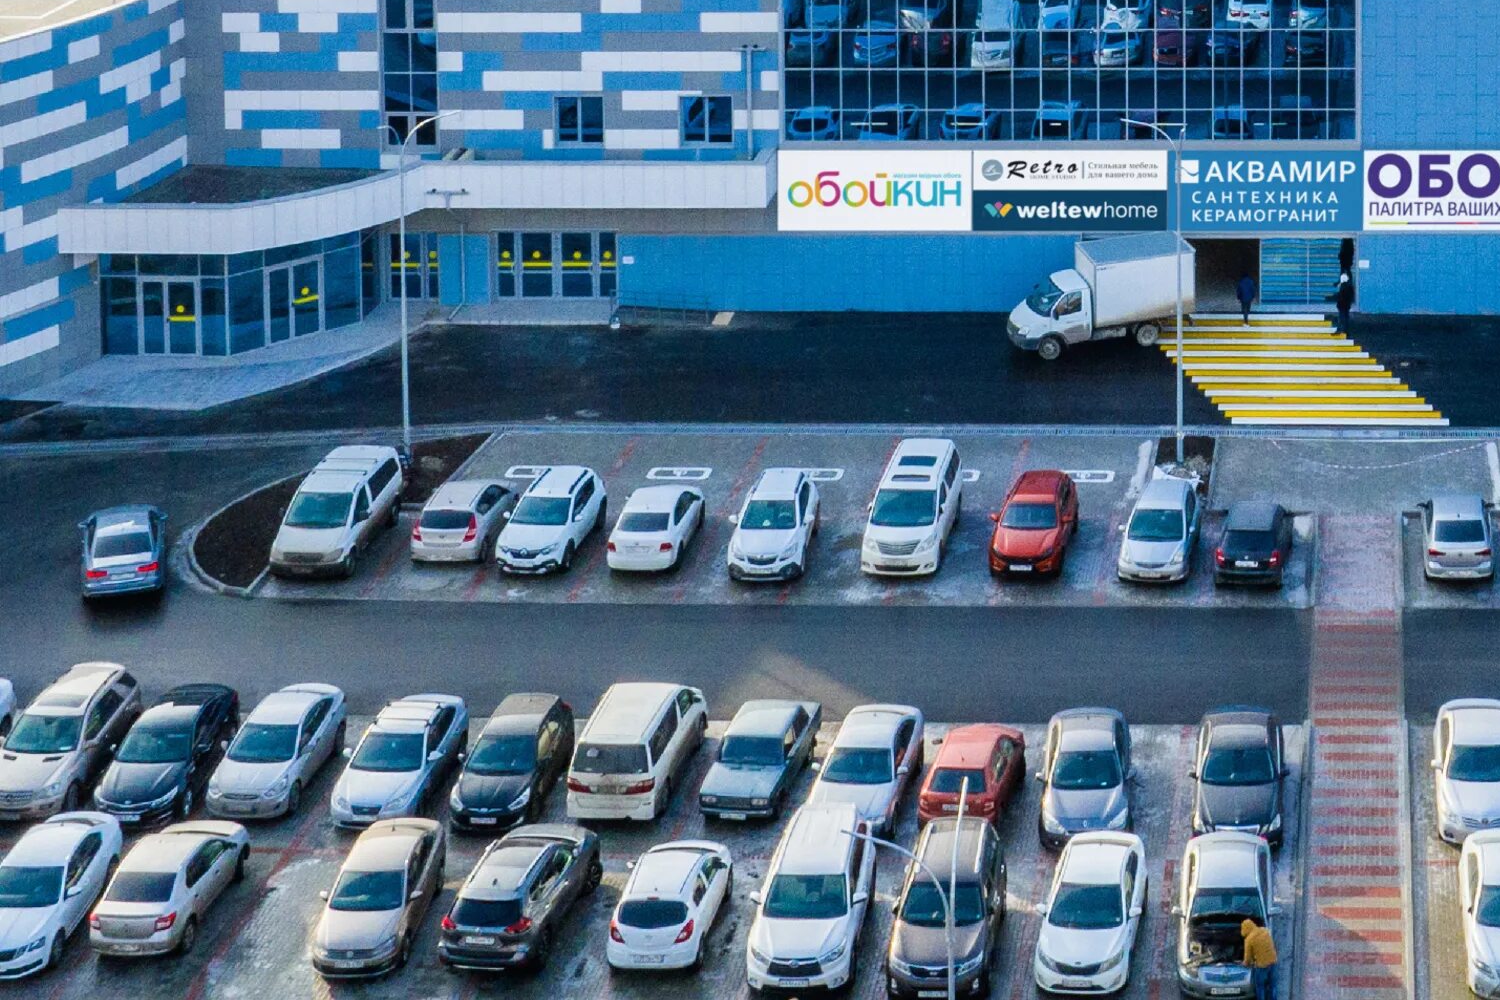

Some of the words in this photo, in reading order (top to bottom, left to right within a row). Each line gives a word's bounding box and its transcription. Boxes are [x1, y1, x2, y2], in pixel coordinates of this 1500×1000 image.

[1007, 160, 1079, 180] Retro
[1088, 161, 1126, 170] Стильная
[1129, 161, 1158, 170] мебель
[1204, 160, 1356, 183] АКВАМИР
[1087, 171, 1102, 179] для
[1105, 171, 1134, 179] вашего
[1136, 171, 1158, 179] дома
[788, 171, 962, 208] обойкин
[1191, 190, 1339, 204] САНТЕХНИКА
[1016, 201, 1158, 219] weltewhome
[1191, 209, 1339, 222] КЕРАМОГРАНИТ
[1369, 202, 1444, 217] ПАЛИТРА
